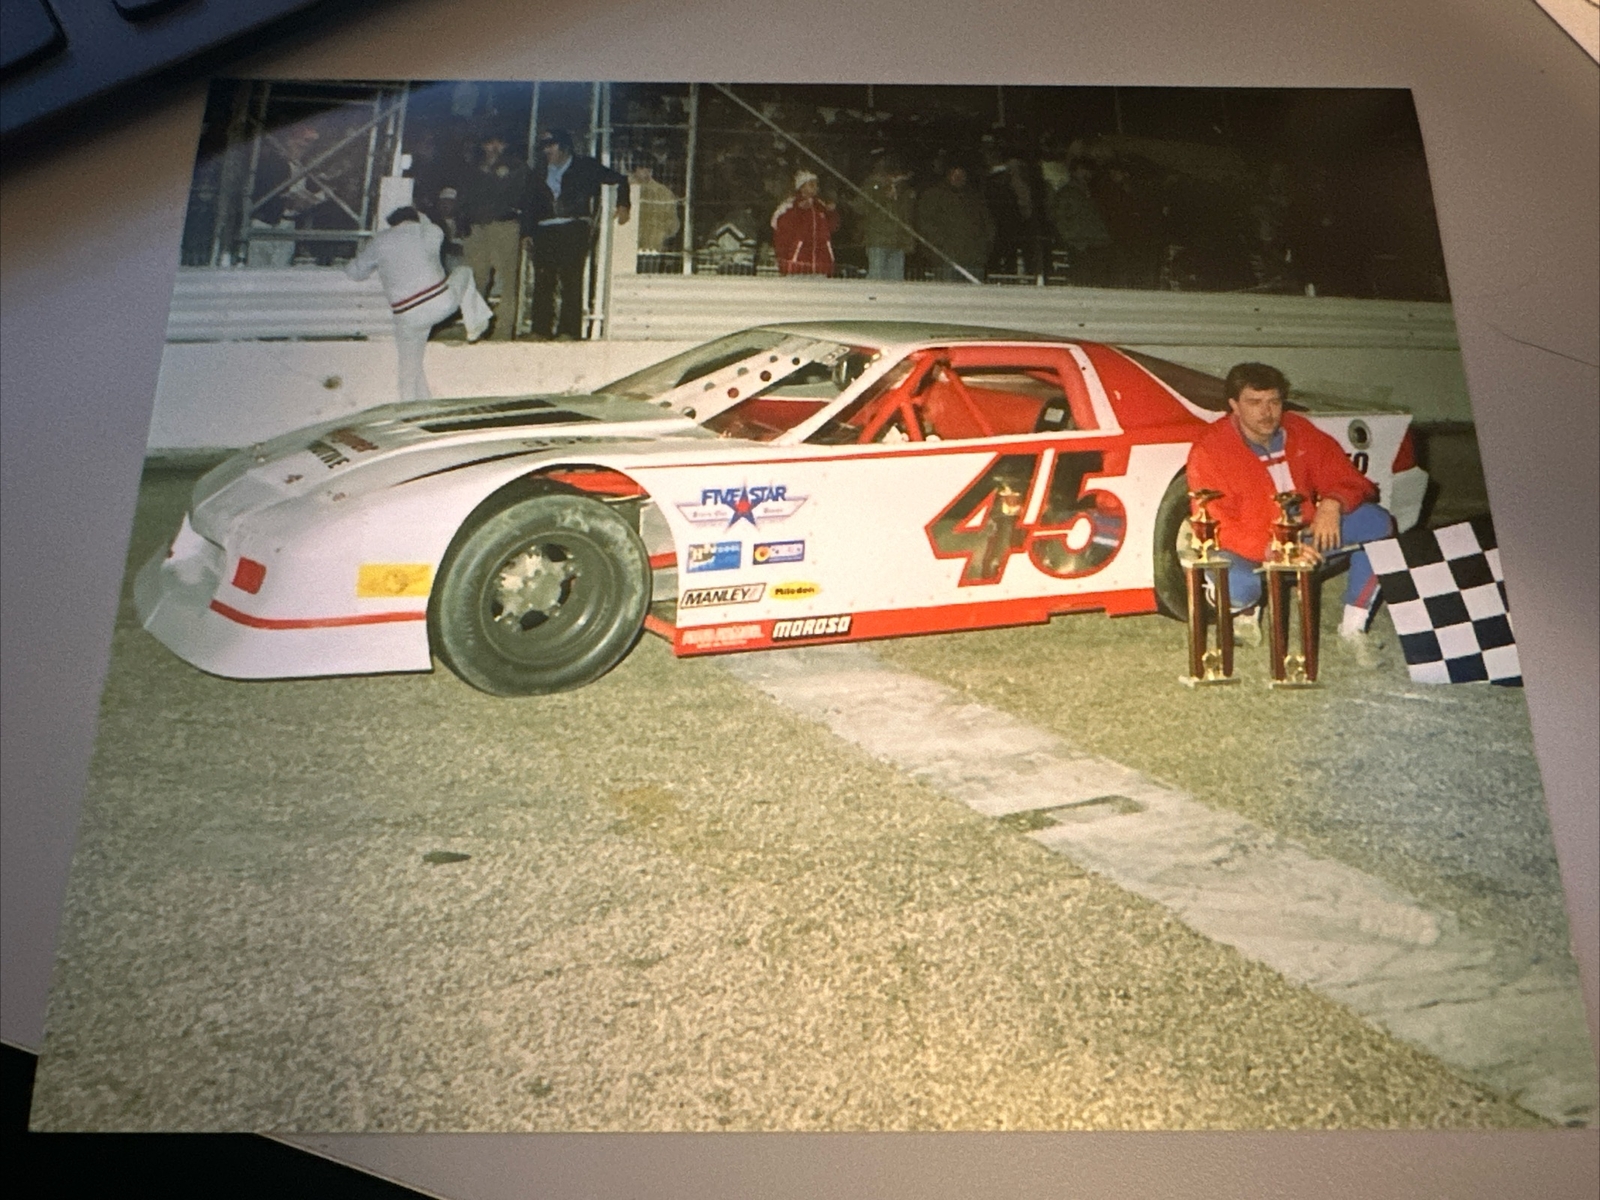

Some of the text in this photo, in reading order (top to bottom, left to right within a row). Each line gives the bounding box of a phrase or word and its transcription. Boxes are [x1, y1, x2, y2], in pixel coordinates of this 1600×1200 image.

[701, 485, 787, 506] FIVE STAR
[924, 449, 1128, 588] 45
[685, 588, 751, 606] MANLEY
[773, 616, 851, 638] MOROSO
